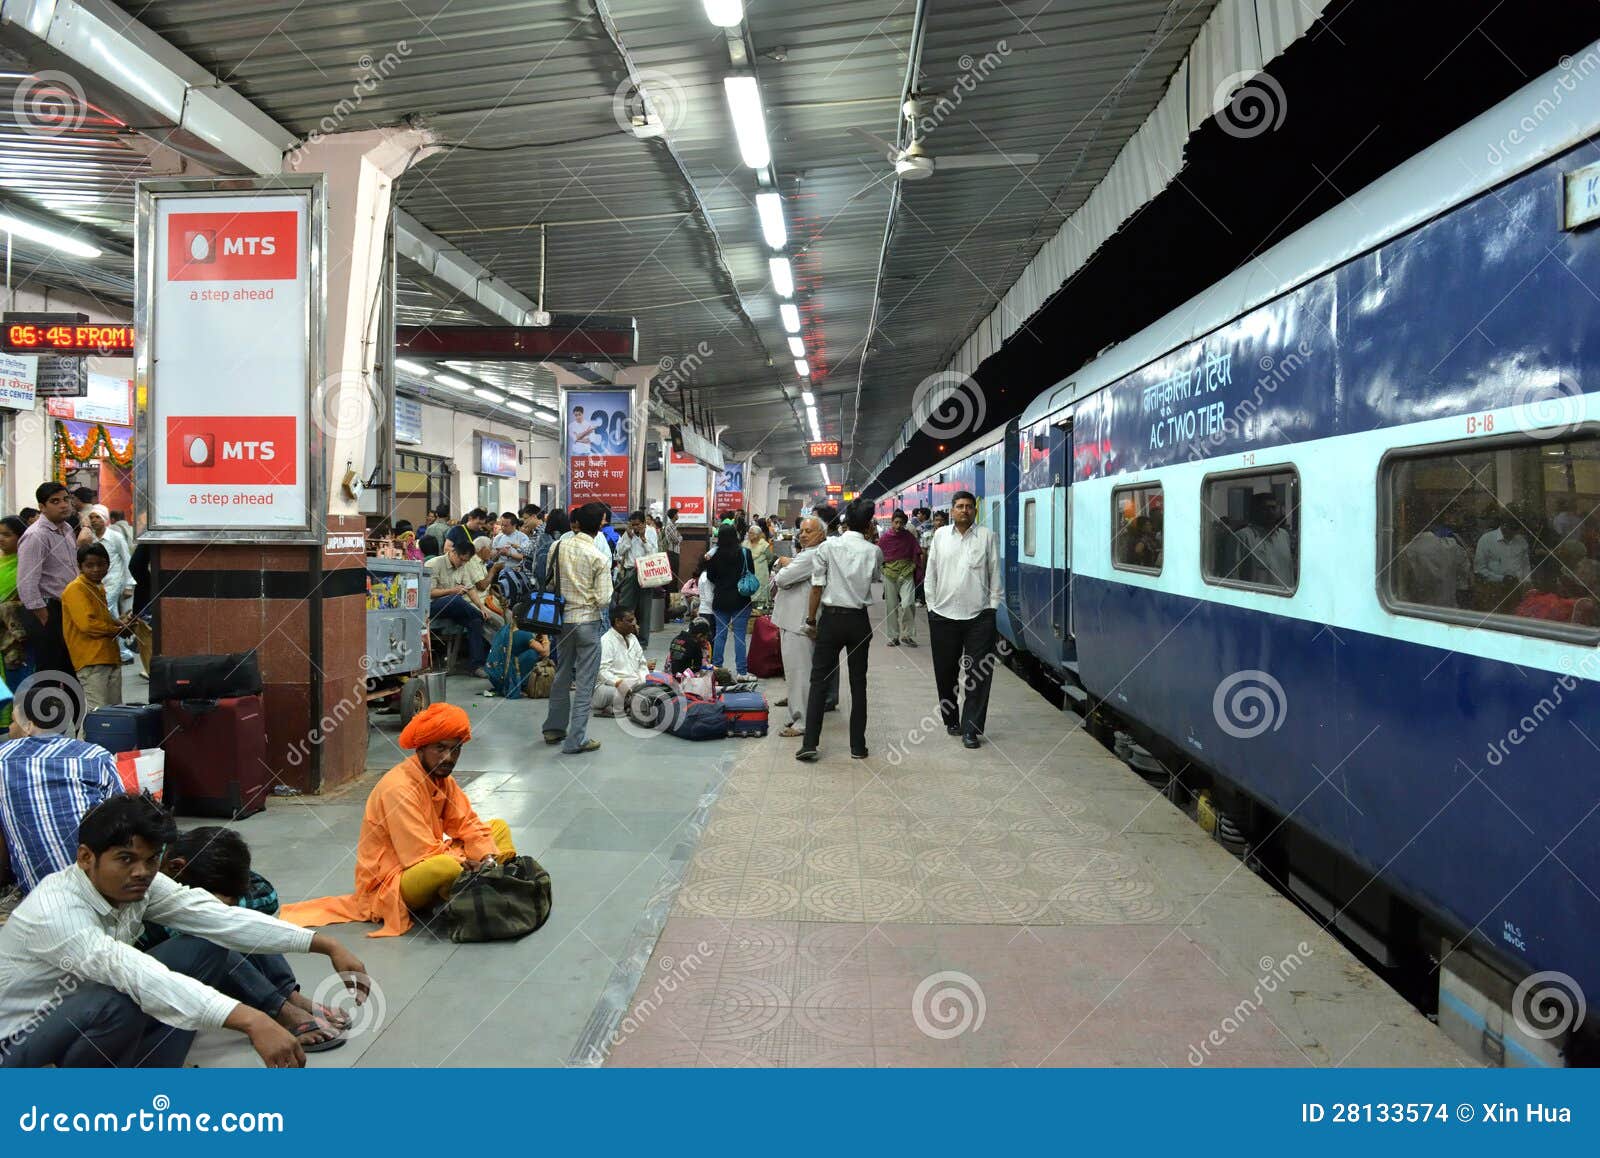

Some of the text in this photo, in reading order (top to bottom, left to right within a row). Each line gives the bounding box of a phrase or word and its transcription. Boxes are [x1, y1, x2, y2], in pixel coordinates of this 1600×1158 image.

[223, 236, 276, 255] MTS
[190, 288, 274, 302] a step ahead
[10, 326, 72, 345] 06:45
[76, 327, 126, 346] FROM
[1194, 366, 1202, 397] 2
[1205, 351, 1232, 393] टियर
[9, 390, 33, 400] CENTRE
[1149, 401, 1225, 450] AC TWO TIER
[1466, 414, 1494, 433] 13-18
[222, 441, 275, 460] MTS
[574, 470, 584, 479] 30
[189, 492, 274, 506] a step ahead
